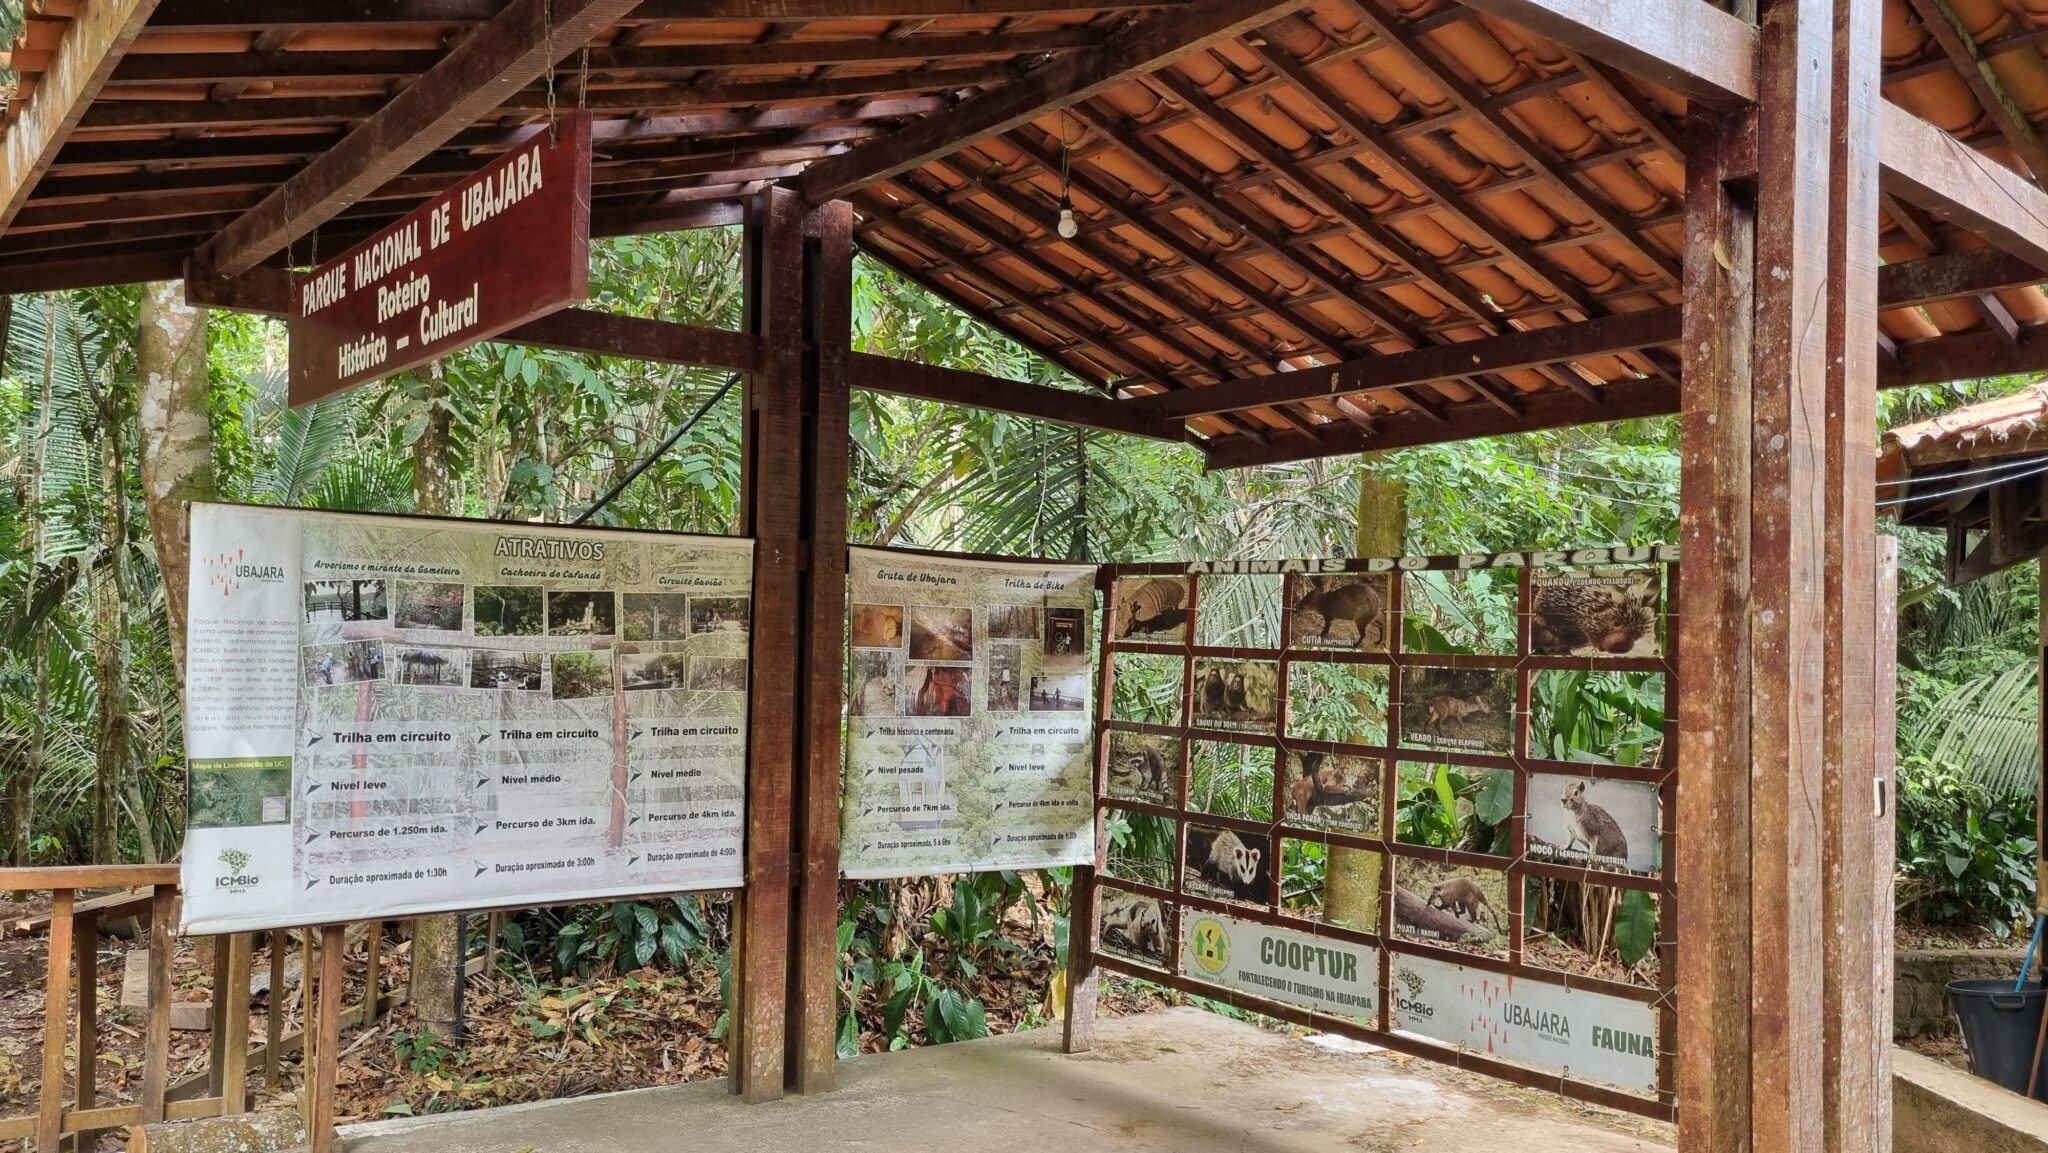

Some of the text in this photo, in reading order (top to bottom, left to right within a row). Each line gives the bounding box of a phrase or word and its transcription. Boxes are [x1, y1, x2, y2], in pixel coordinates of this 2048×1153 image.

[302, 145, 542, 318] PARQUE NACIONAL DE UBAJARA
[378, 270, 430, 324] Roteiro
[338, 282, 478, 380] Histórico Cultural
[494, 537, 605, 561] ATRATIVOS
[314, 559, 360, 571] Arvorismo
[368, 562, 402, 573] mirante
[404, 563, 416, 574] da
[417, 564, 461, 576] Gameleira
[1187, 558, 1346, 574] ANIMAIS
[1368, 556, 1429, 572] DO
[235, 565, 285, 579] UBAJARA
[500, 567, 601, 580] Cachoeira do Cafundó
[877, 570, 957, 586] Gruta de Ubajara
[658, 576, 723, 587] Circuito Gavião
[1004, 579, 1065, 591] Trilha de Bike
[223, 618, 253, 626] Nacional
[1302, 635, 1322, 645] CUTIA
[499, 728, 599, 740] Trilha em circuito
[651, 725, 739, 737] Trilha em circuito
[879, 727, 896, 736] Trilha
[1009, 726, 1032, 735] Trilha
[1047, 726, 1079, 735] circuito
[333, 731, 451, 744] Trilha em circuito
[1410, 733, 1431, 743] VEADO
[223, 761, 263, 769] Localização
[899, 766, 924, 776] pesado
[1029, 763, 1045, 771] leve
[501, 773, 561, 785] Nível médio
[676, 768, 702, 778] médio
[331, 780, 387, 791] Nível leve
[877, 803, 951, 814] Percurso de 7km ida.
[1008, 800, 1031, 809] Percurso
[1032, 800, 1039, 808] de
[1039, 800, 1050, 808] 4km
[1050, 799, 1060, 807] ida
[1065, 799, 1079, 807] volta
[648, 809, 737, 822] Percurso de 4km ida.
[495, 820, 539, 830] Percurso
[541, 819, 554, 828] de
[556, 817, 577, 827] 3km
[329, 824, 448, 839] Percurso de 1.250m ida.
[1006, 834, 1026, 843] Duração
[1027, 833, 1056, 842] aproximada
[877, 841, 899, 851] Duração
[933, 839, 937, 847] 5
[1530, 842, 1553, 856] MOCÓ
[647, 847, 737, 862] Duração aproximada de 4:00h
[495, 857, 595, 874] Duração aproximada de 3:00h
[215, 875, 259, 887] ICMBio
[329, 868, 447, 886] Duração aproximada de 1:30h
[1260, 936, 1357, 982] COOPTUR
[1238, 970, 1286, 990] FORTALECENDO
[1287, 981, 1292, 992] O
[1293, 982, 1324, 999] TURISMO
[1325, 990, 1336, 1002] NA
[1336, 992, 1372, 1010] IBIAPABA
[1396, 997, 1433, 1016] ICMBio
[1409, 1015, 1423, 1024] MMA
[1503, 1002, 1571, 1038] UBAJARA
[1538, 1033, 1570, 1046] PARQUE NACIONAL
[1592, 1025, 1654, 1059] FAUNA
